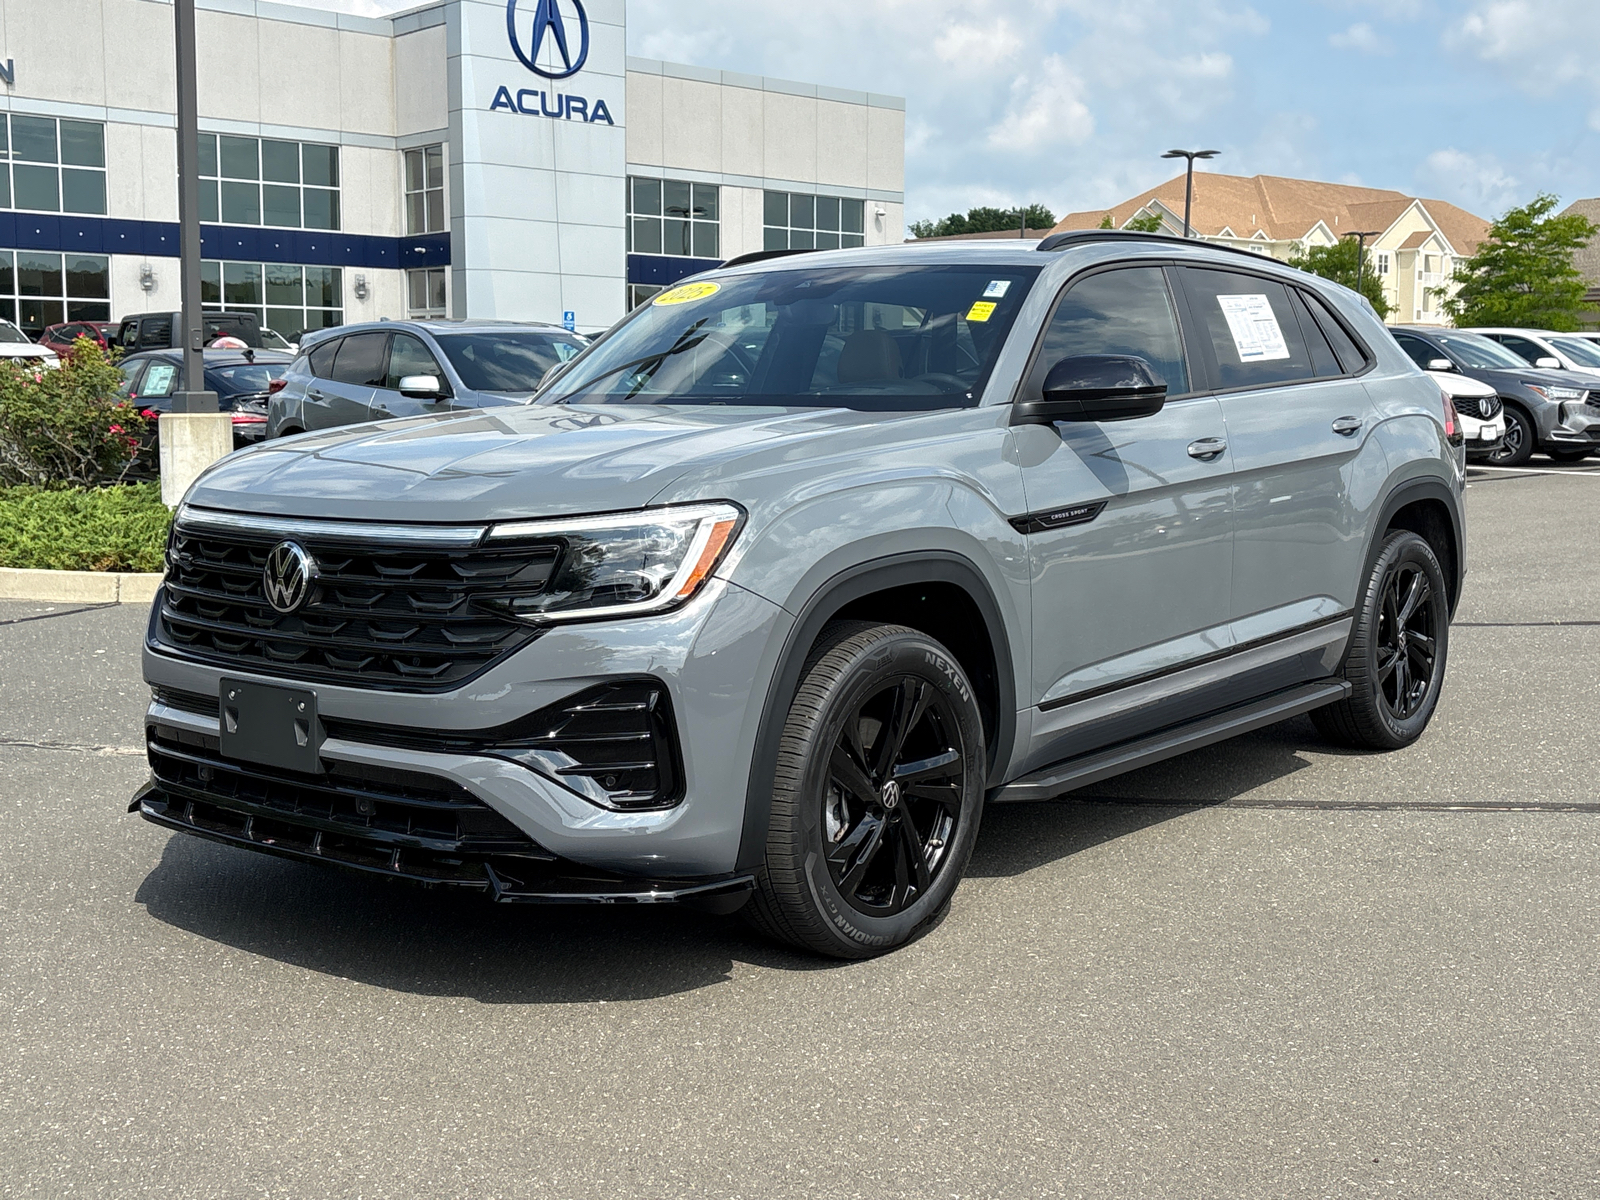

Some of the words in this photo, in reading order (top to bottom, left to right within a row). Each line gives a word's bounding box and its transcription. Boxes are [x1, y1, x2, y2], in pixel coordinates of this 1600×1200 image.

[489, 85, 615, 125] ACURA
[1050, 512, 1070, 520] CROSS
[1070, 507, 1089, 517] SPORT
[924, 652, 970, 703] NEXEN
[820, 885, 838, 914] GTX
[833, 914, 895, 947] ROADIAN
